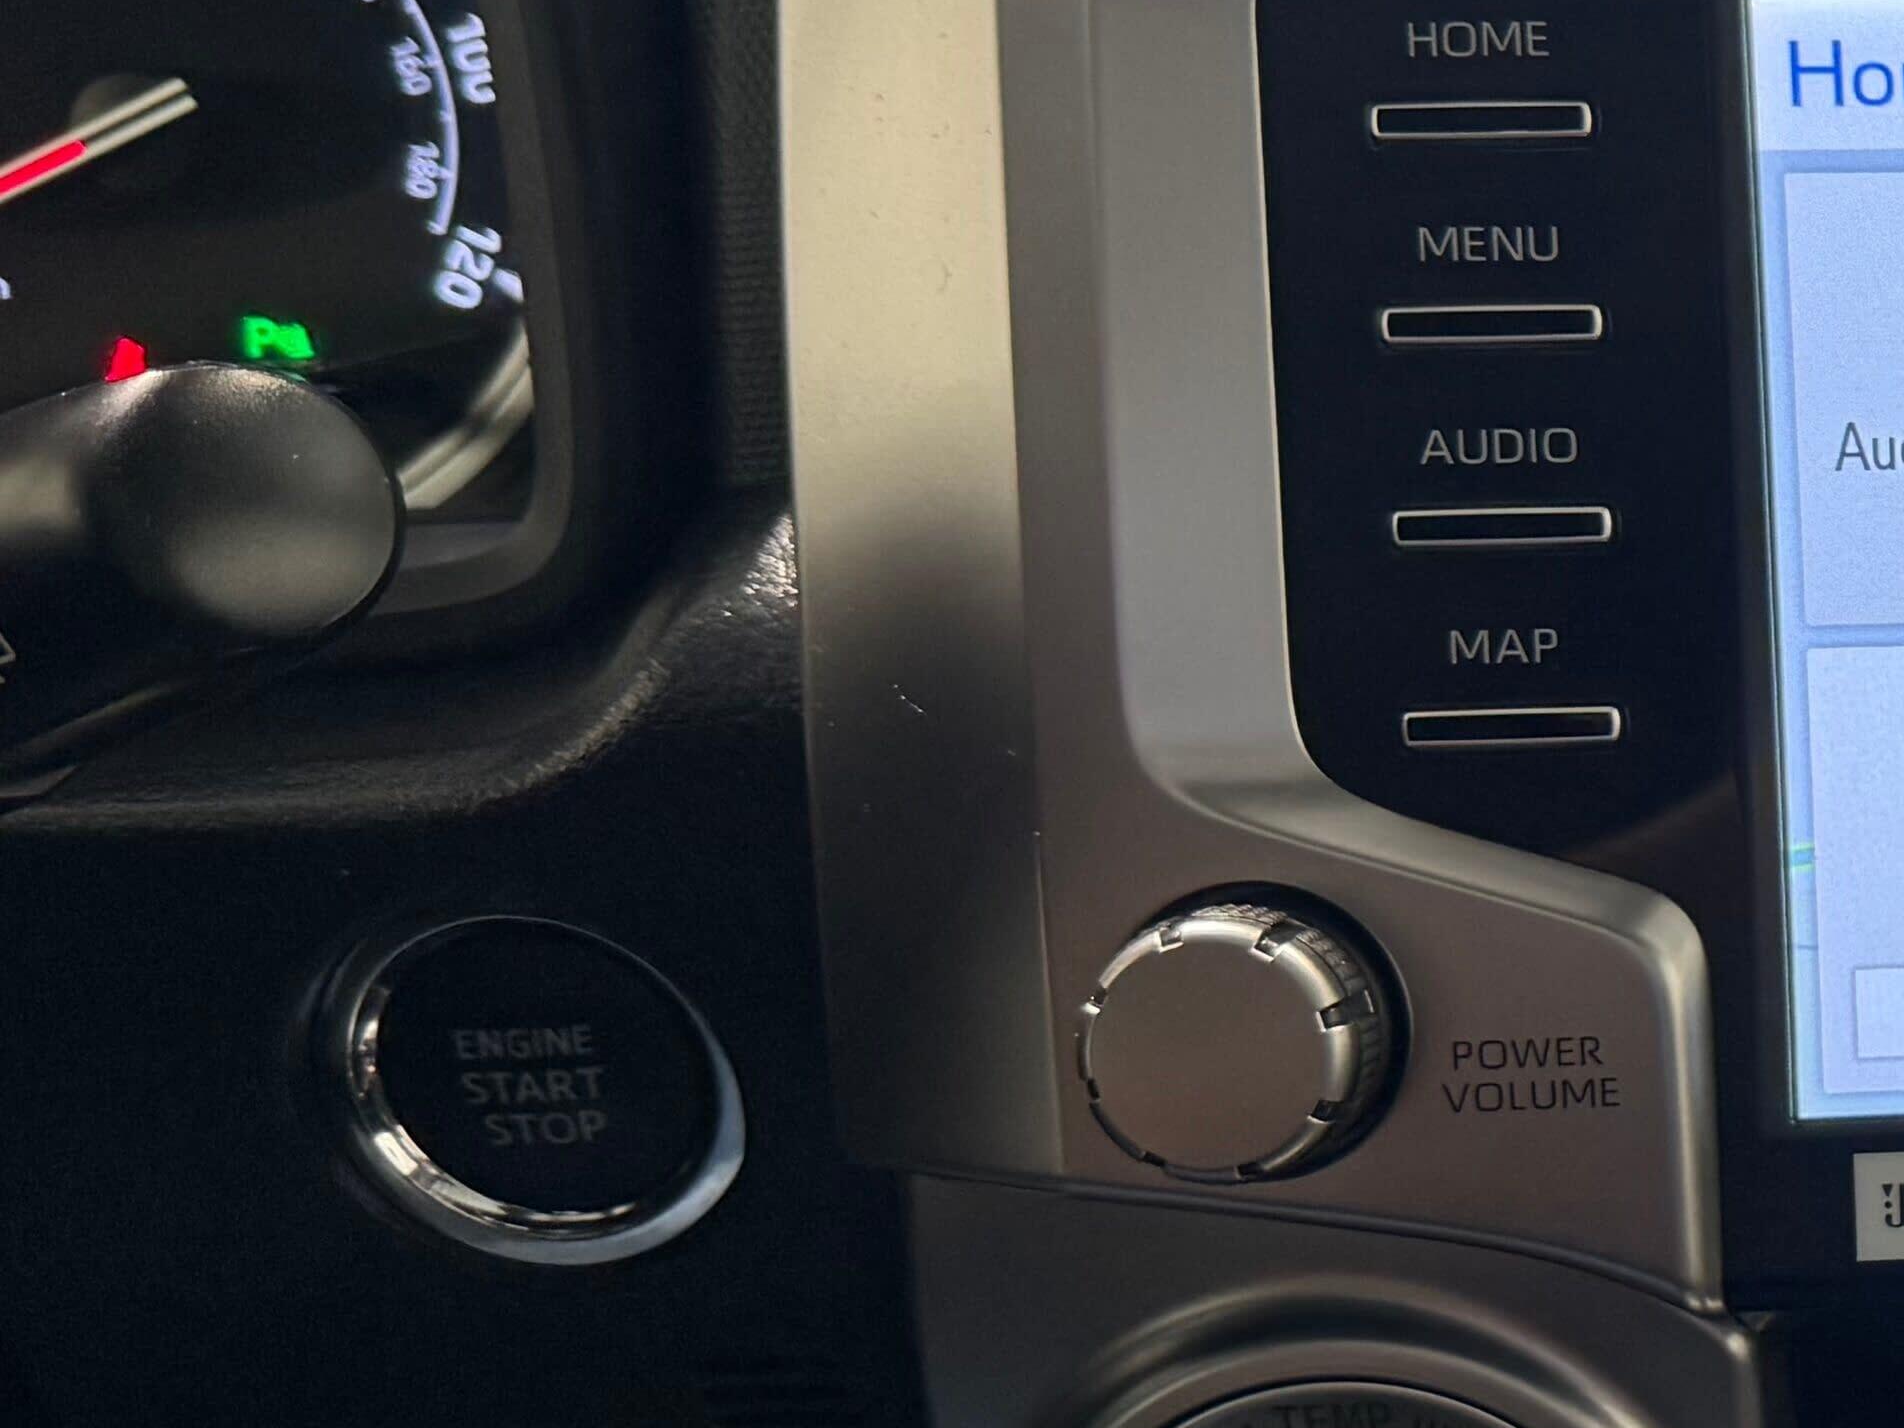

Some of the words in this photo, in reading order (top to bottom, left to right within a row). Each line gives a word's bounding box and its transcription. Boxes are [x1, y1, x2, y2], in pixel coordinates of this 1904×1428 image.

[1406, 19, 1551, 59] HOME
[390, 36, 432, 97] 160
[404, 141, 440, 200] 180
[1416, 224, 1561, 264] MENU
[436, 225, 502, 310] 120
[1419, 425, 1580, 467] AUDIO
[1447, 627, 1561, 665] MAP
[454, 1023, 594, 1061] ENGINE
[1451, 1035, 1605, 1071] POWER
[460, 1066, 605, 1106] START
[1440, 1077, 1623, 1115] VOLUME
[484, 1111, 608, 1148] STOP
